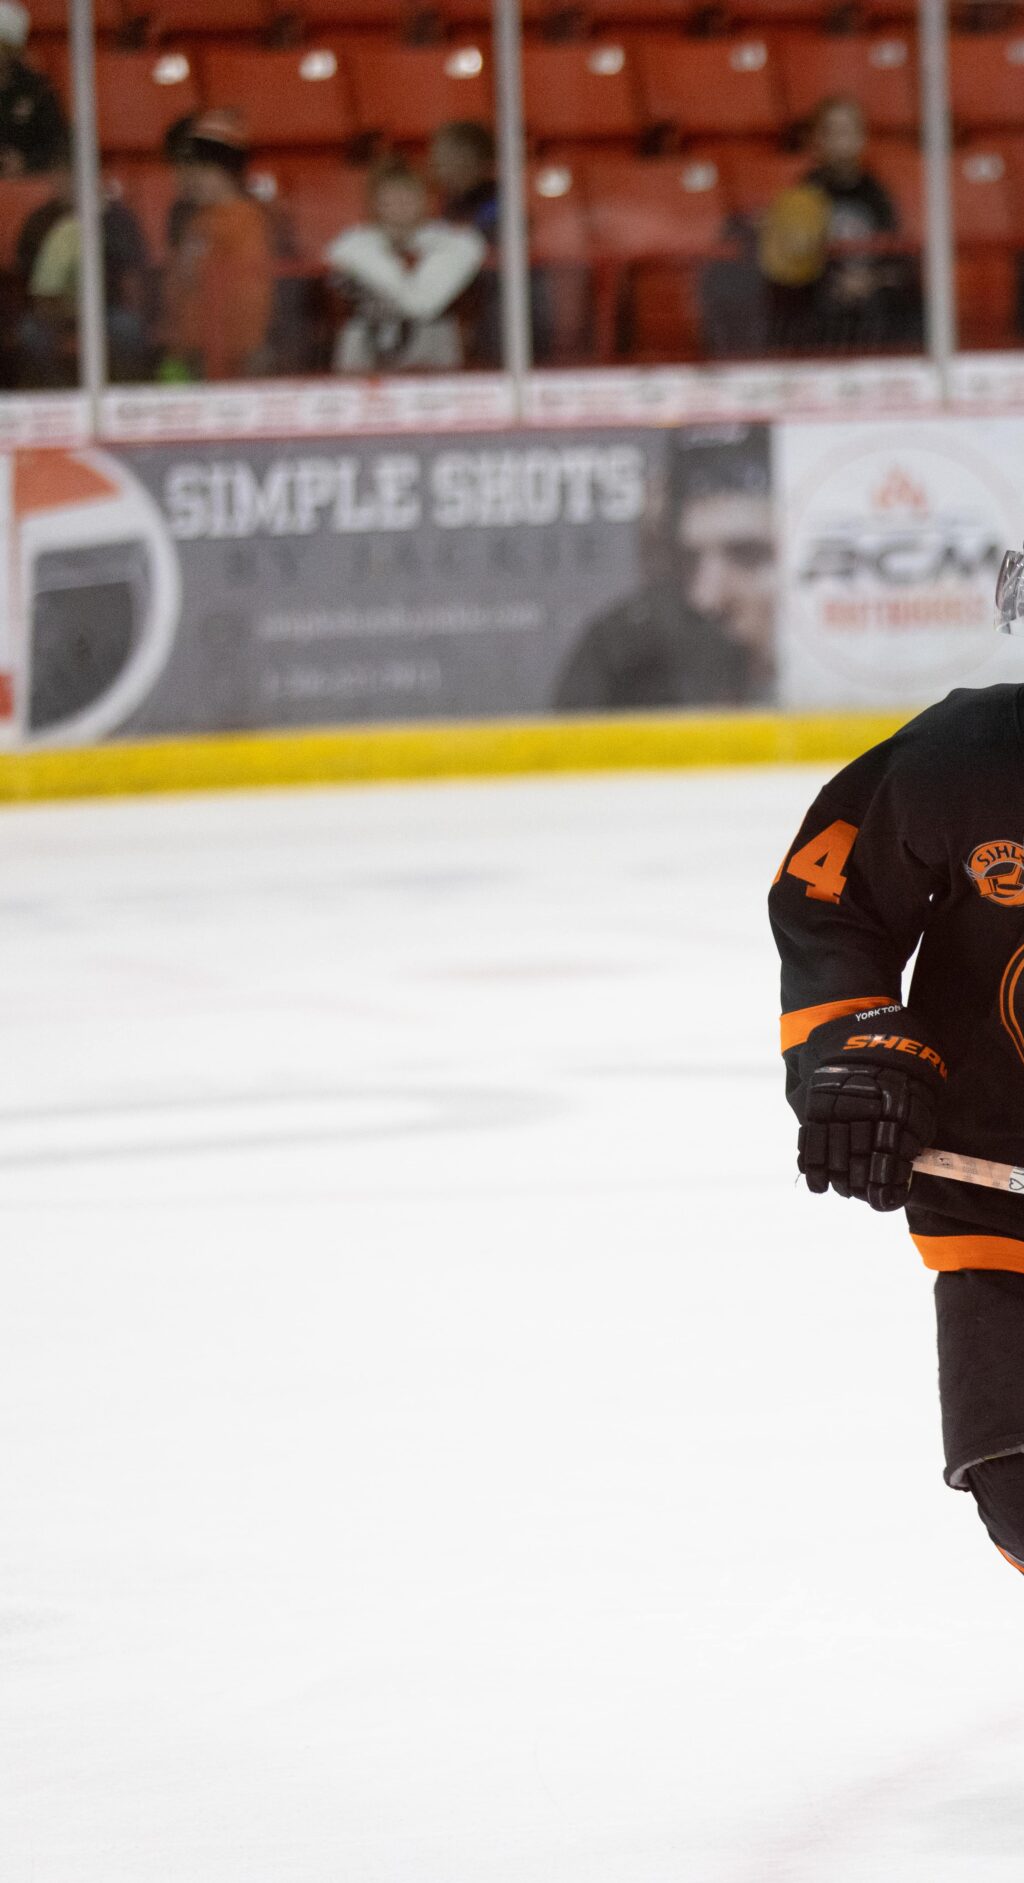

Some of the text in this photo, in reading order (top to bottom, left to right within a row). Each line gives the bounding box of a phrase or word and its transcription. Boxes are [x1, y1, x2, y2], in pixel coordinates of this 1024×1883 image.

[166, 447, 644, 538] SIMPLE SHOTS
[772, 819, 859, 905] 4
[976, 845, 1021, 868] SJHL
